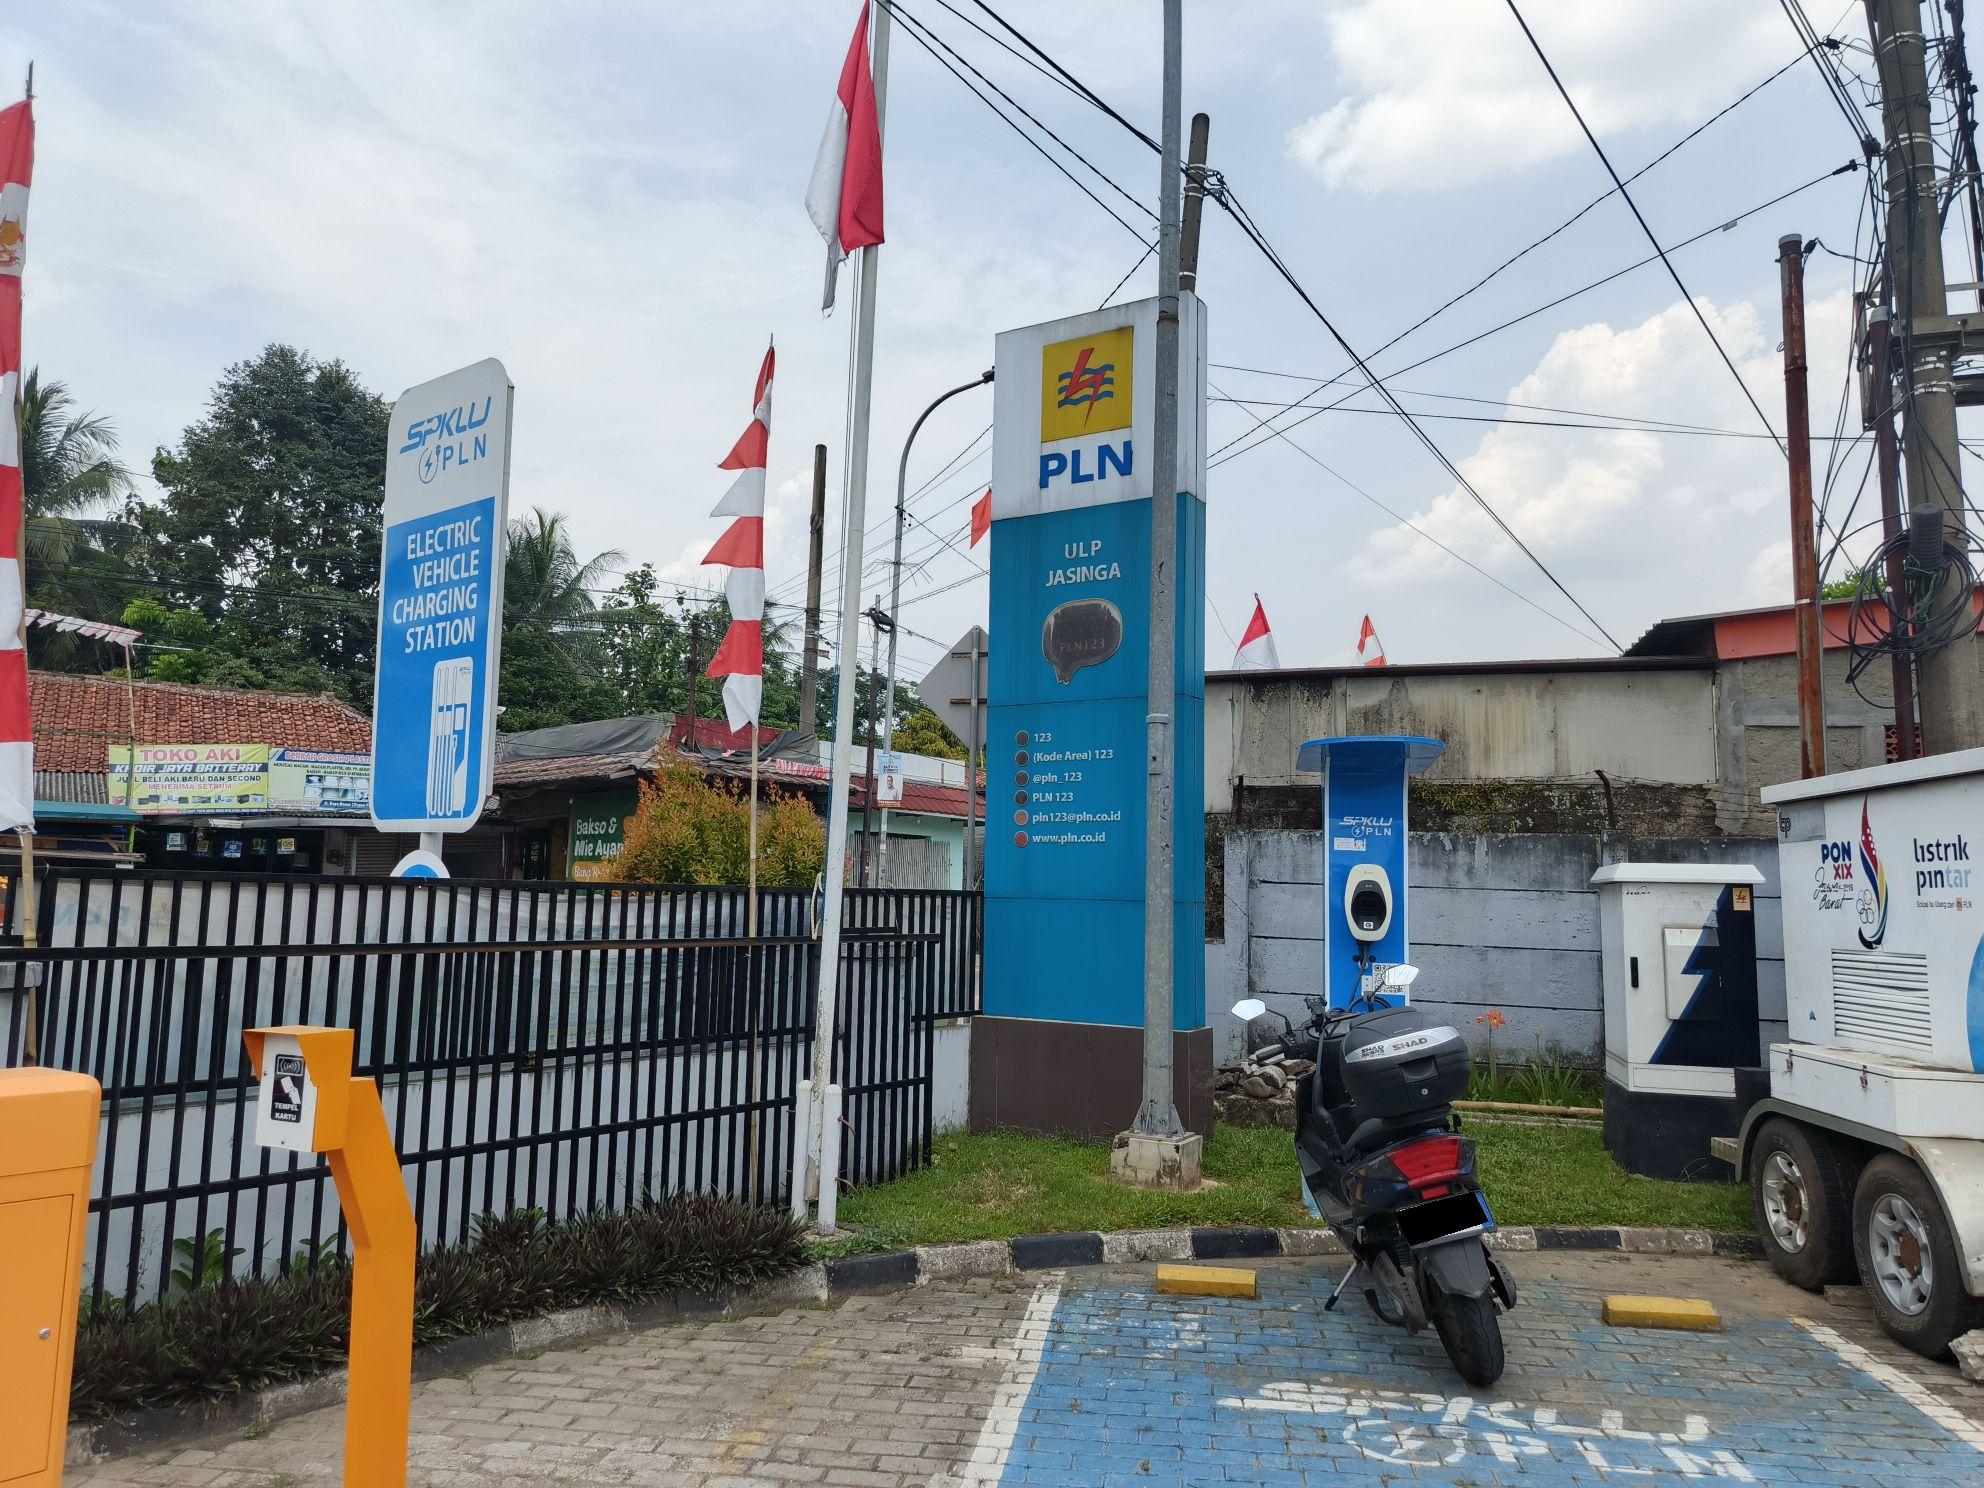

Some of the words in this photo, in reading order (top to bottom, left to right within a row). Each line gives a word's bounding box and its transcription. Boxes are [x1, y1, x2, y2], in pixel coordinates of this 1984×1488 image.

[400, 396, 492, 455] SPKLU
[443, 434, 487, 471] PLN
[1039, 440, 1133, 489] PLN
[407, 515, 482, 560] ELECTRIC
[1064, 540, 1102, 560] ULP
[413, 549, 480, 589] VEHICLE
[1046, 563, 1121, 587] JASINGA
[392, 582, 478, 625] CHARGING
[405, 615, 476, 654] STATION
[1060, 639, 1105, 652] PLN123
[1034, 733, 1052, 742] 123
[140, 749, 198, 762] TOKO
[205, 748, 241, 761] AKI
[1033, 752, 1062, 763] (Kode
[1064, 750, 1092, 761] Area)
[1094, 749, 1114, 759] 123
[158, 764, 192, 773] JAYA
[1033, 772, 1082, 784] @pln_123
[1032, 793, 1053, 802] PLN
[1055, 792, 1074, 802] 123
[576, 817, 607, 835] Bakso
[608, 817, 617, 834] &
[1032, 811, 1121, 824] pln123@pln.co.id
[1339, 816, 1393, 826] SPKLU
[1032, 832, 1106, 845] www.pln.co.id
[1365, 827, 1392, 836] PLN
[574, 839, 594, 857] Mie
[1821, 841, 1852, 864] PON
[1914, 834, 1970, 863] listrik
[1833, 863, 1854, 880] XIX
[1916, 865, 1972, 896] pintar
[1392, 1037, 1428, 1051] SHAD
[274, 1102, 299, 1112] TEMPEL
[274, 1112, 297, 1121] KARTU
